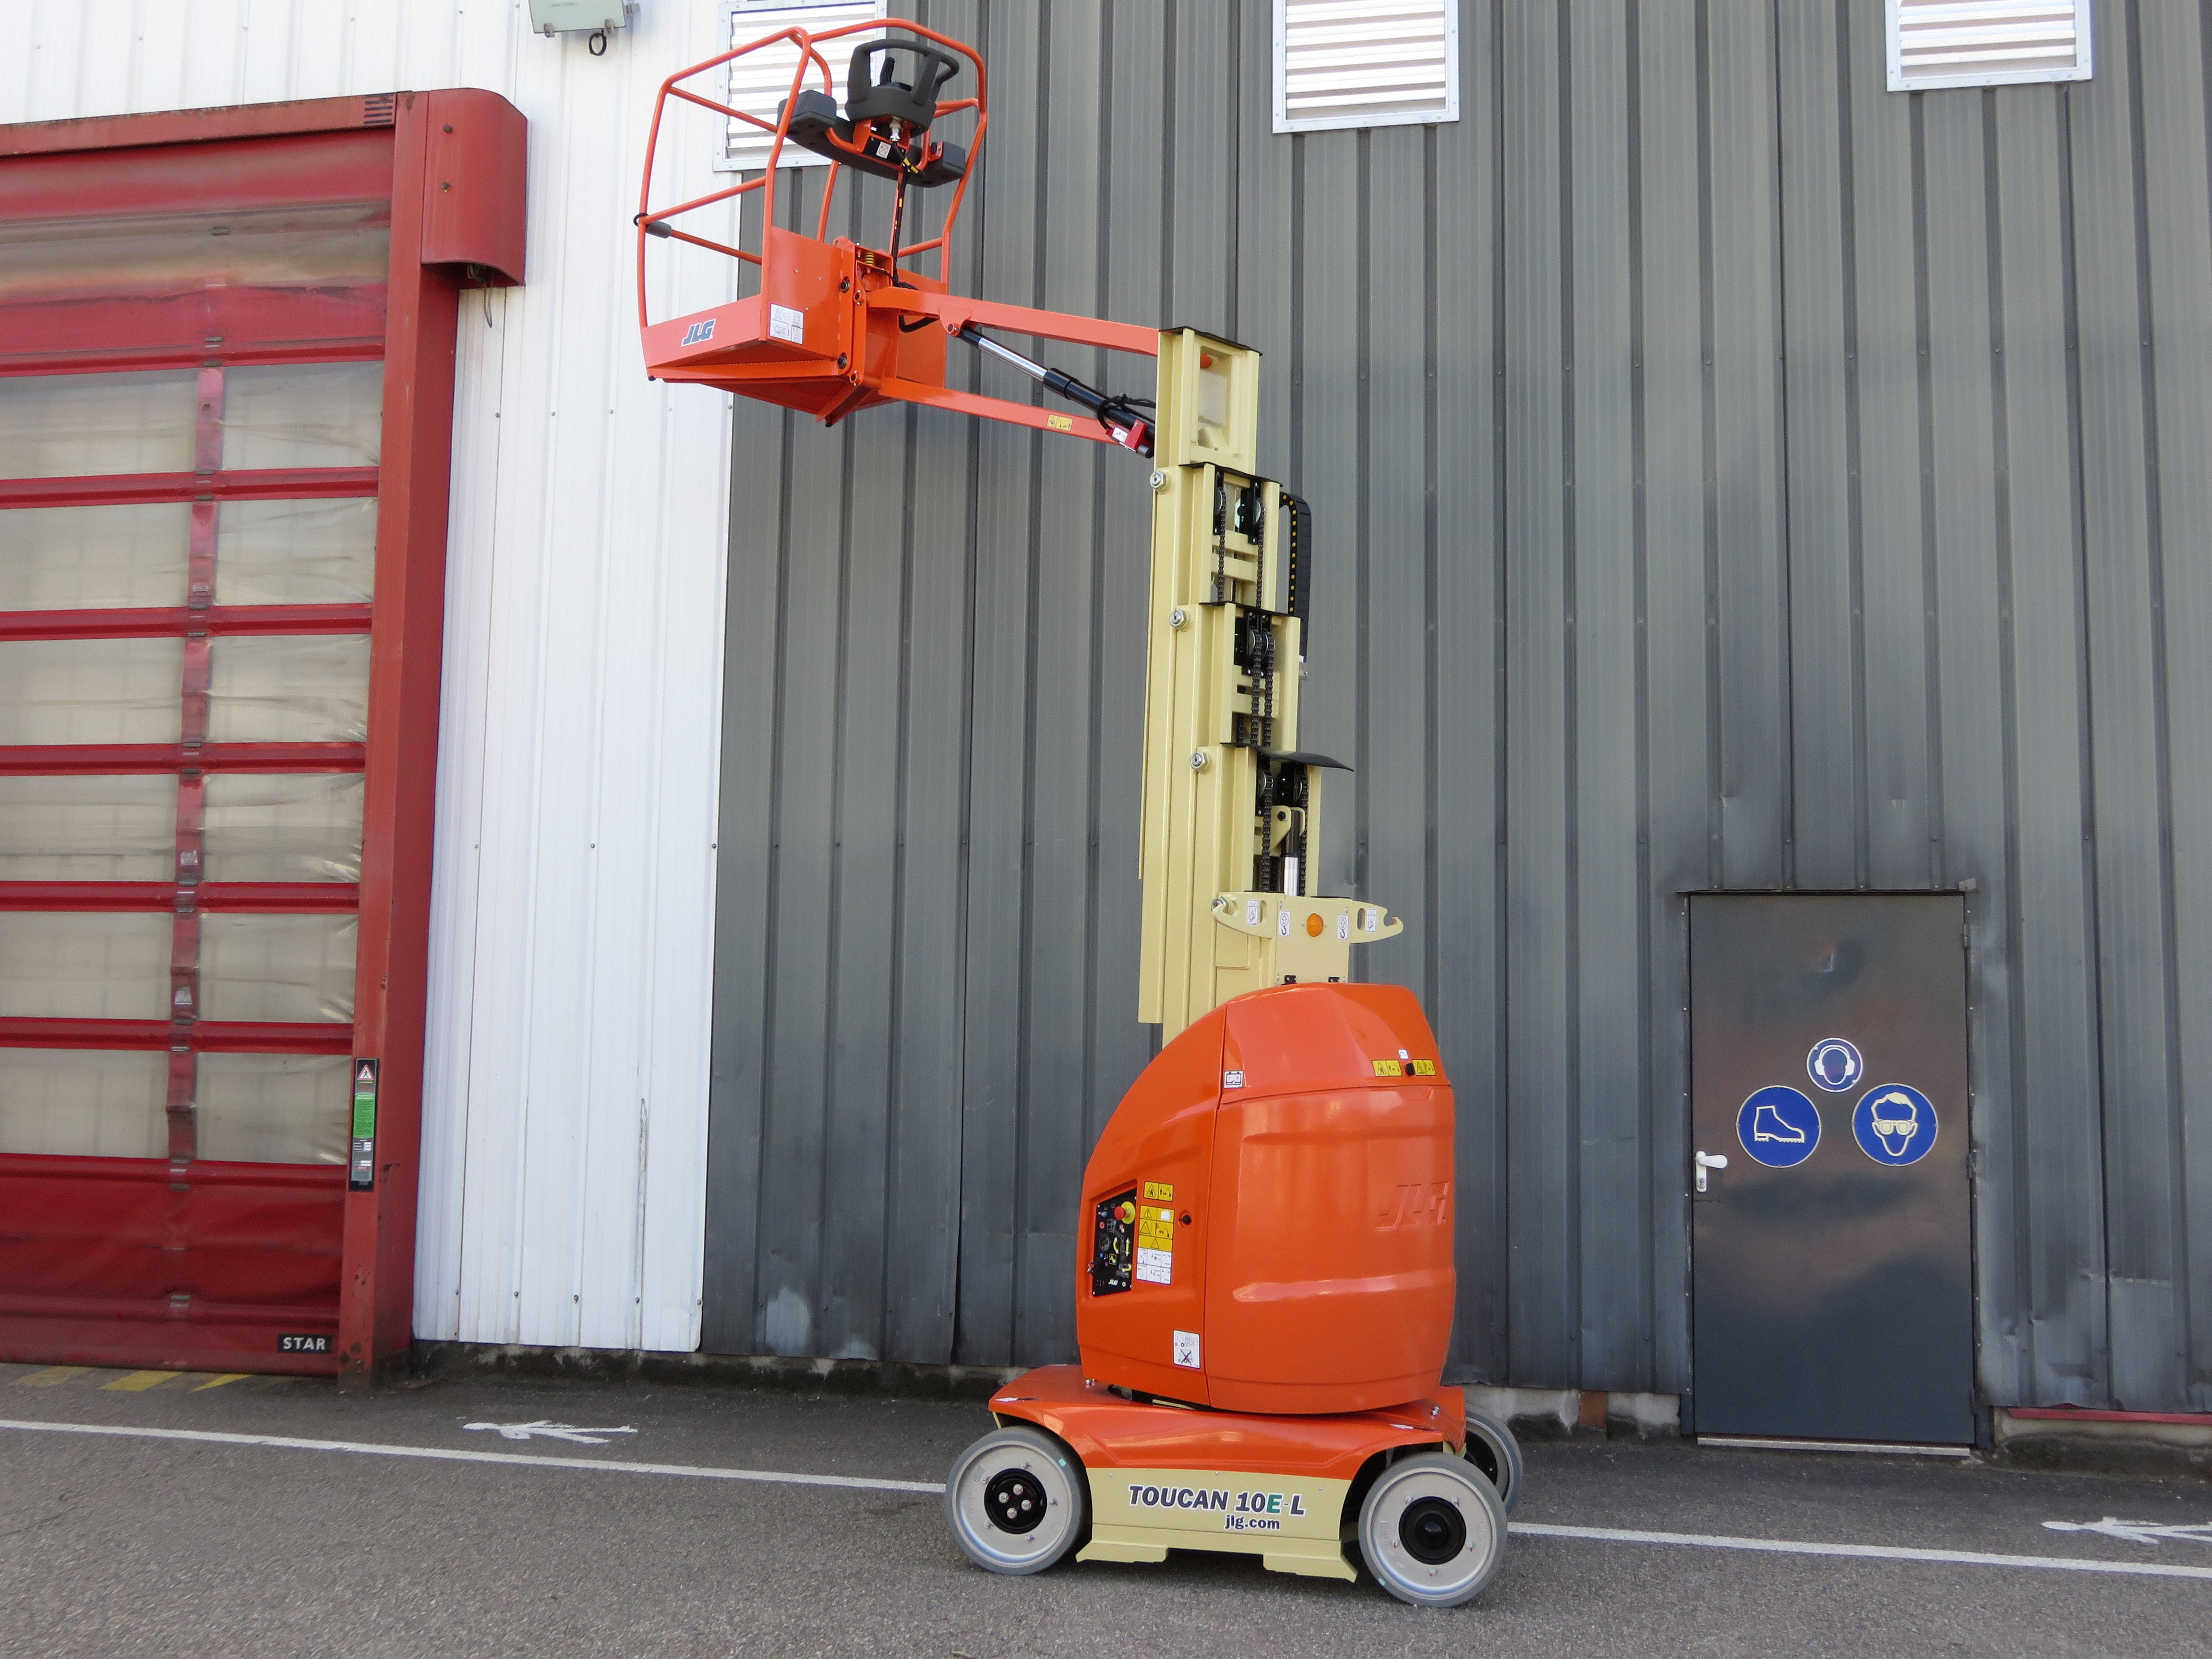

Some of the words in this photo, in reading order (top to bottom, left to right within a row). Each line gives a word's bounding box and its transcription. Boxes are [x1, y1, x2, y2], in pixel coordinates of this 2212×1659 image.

[681, 319, 715, 347] JLG
[283, 1336, 325, 1350] STAR
[1129, 1485, 1229, 1510] TOUCAN
[1225, 1515, 1280, 1529] jlg.com
